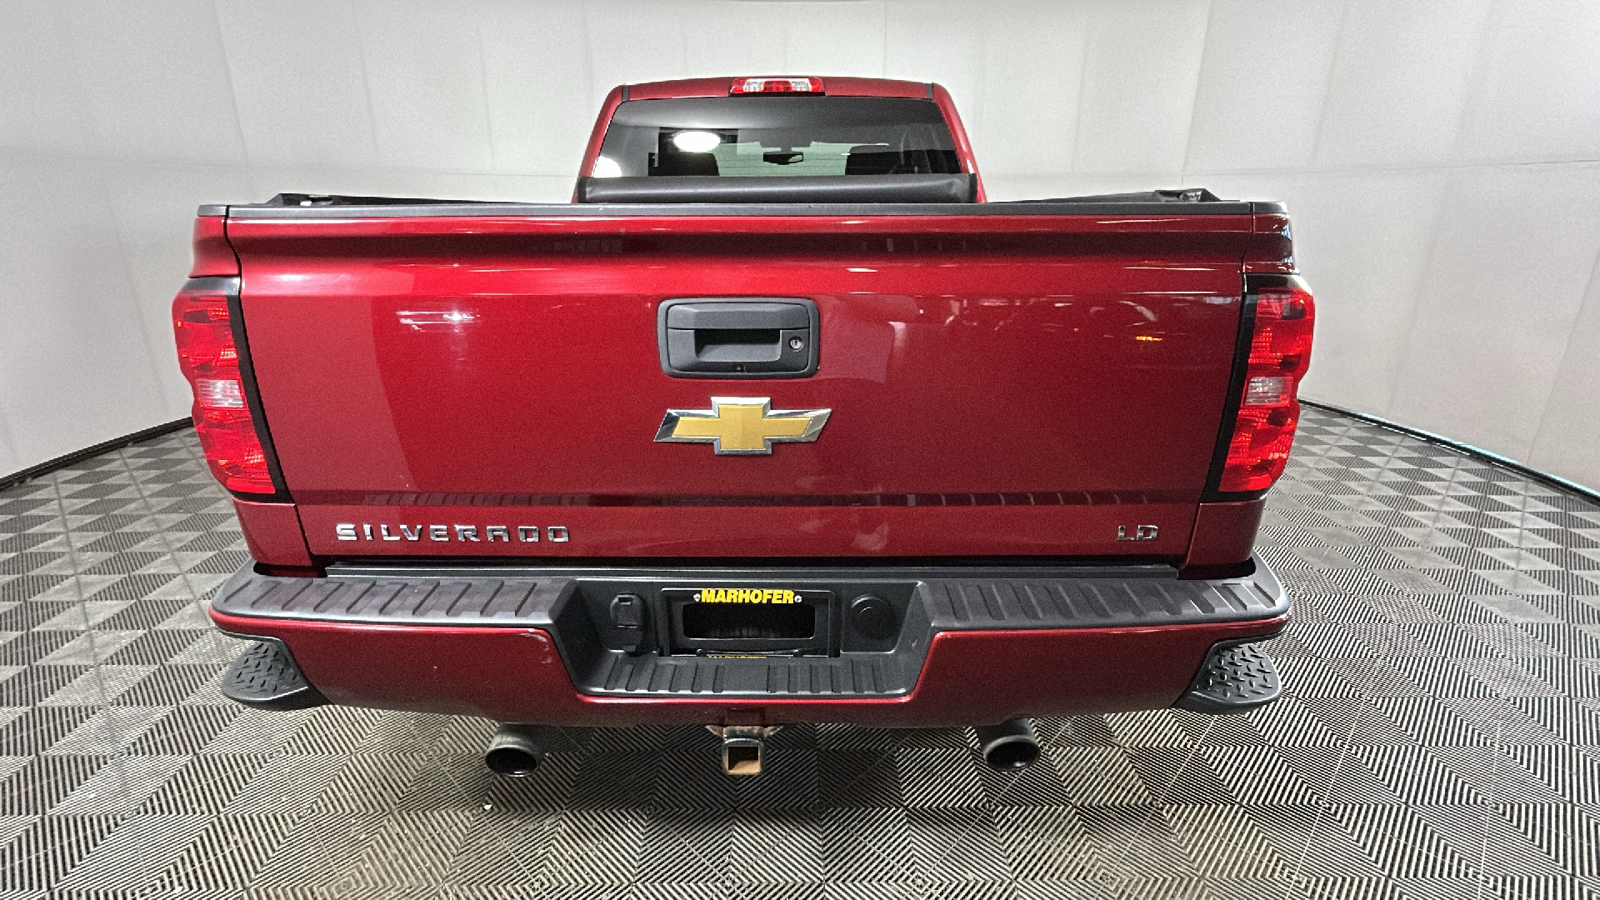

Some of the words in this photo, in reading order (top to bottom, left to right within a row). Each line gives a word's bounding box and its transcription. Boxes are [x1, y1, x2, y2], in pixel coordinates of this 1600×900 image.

[335, 523, 570, 542] SILVERADO
[1117, 524, 1159, 541] LD
[701, 588, 795, 604] MARHOFER
